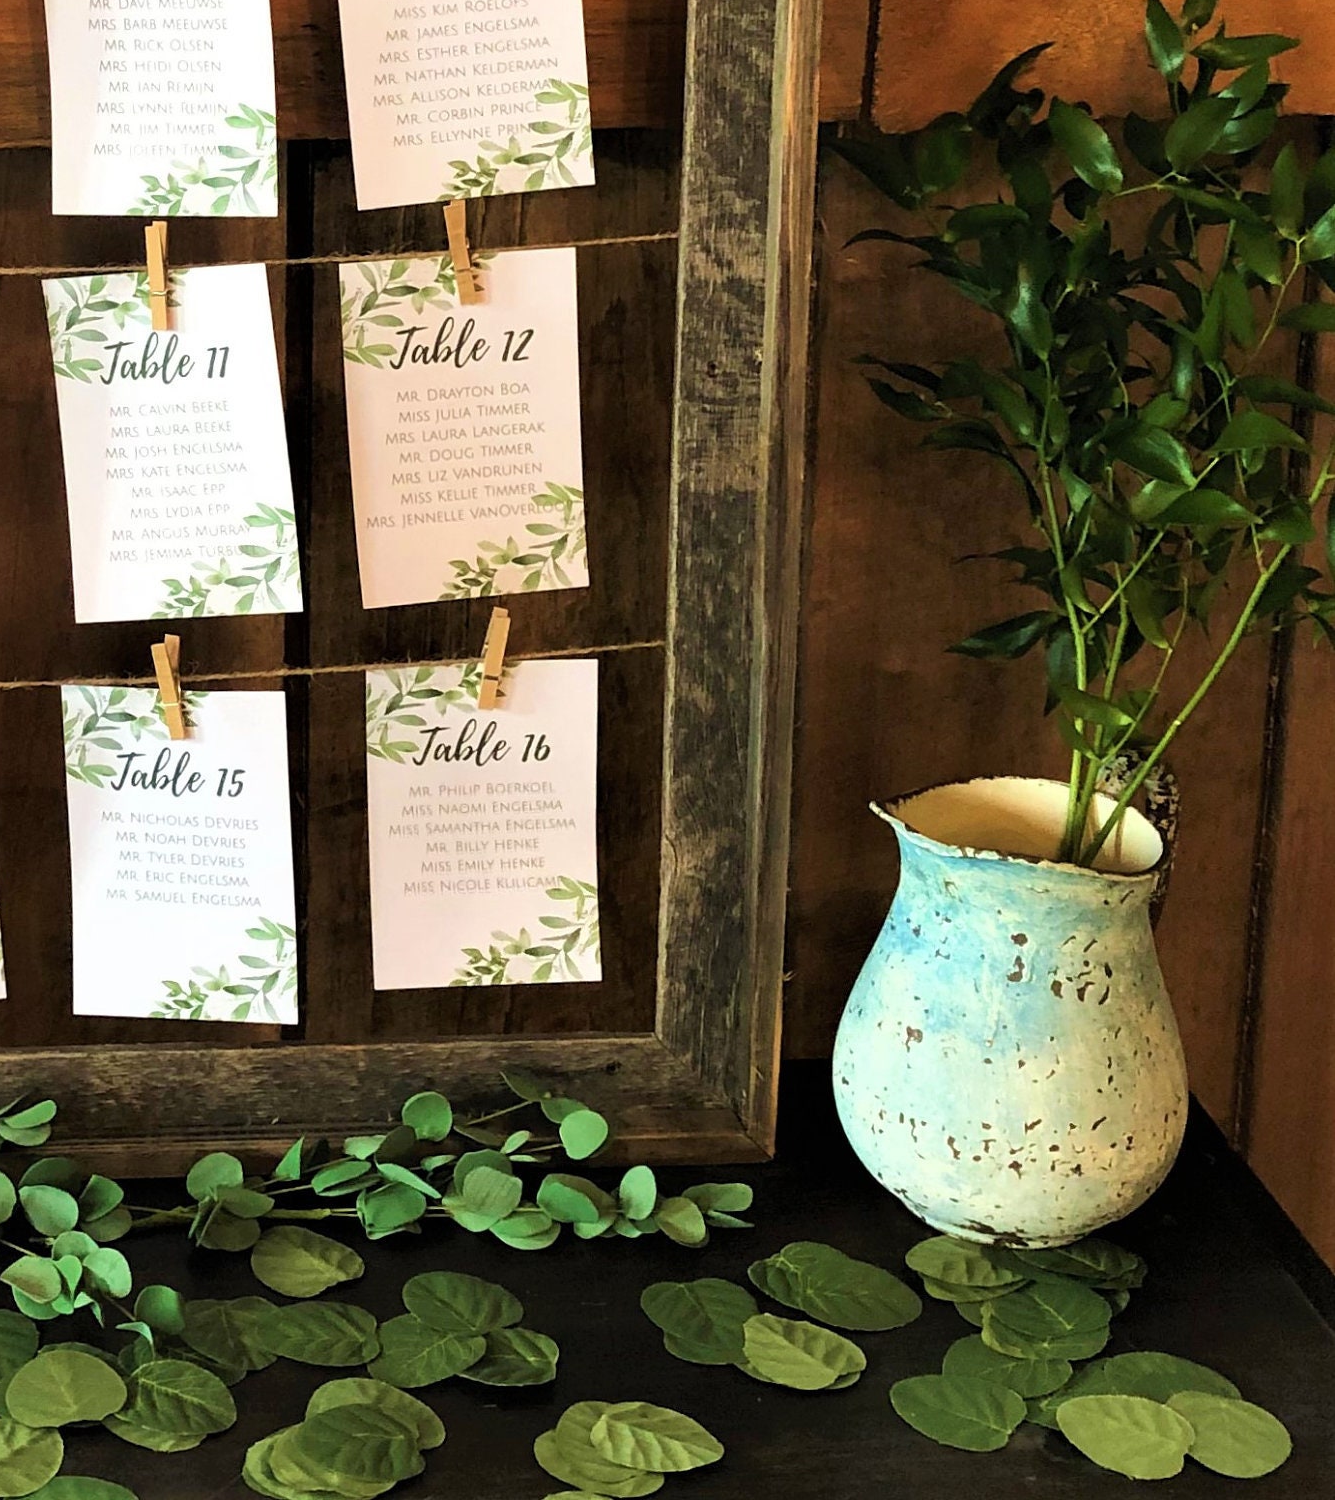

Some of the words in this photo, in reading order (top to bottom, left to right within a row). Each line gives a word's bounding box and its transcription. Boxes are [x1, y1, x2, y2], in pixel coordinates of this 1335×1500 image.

[416, 44, 470, 61] ESTHER
[474, 36, 551, 55] ENGELSMA
[390, 317, 490, 369] Table
[502, 328, 534, 362] 12
[100, 332, 195, 385] Table
[207, 346, 229, 379] 11
[500, 381, 531, 396] BOA
[398, 409, 431, 424] MISS
[435, 406, 472, 425] JULIA
[475, 402, 531, 417] TIMMER
[421, 427, 468, 443] LAURA
[472, 421, 546, 439] LANGERAK
[412, 718, 510, 767] Table
[522, 734, 550, 763] 16
[111, 748, 205, 797] Table
[216, 768, 245, 798] 15
[130, 811, 200, 828] NICHOLAS
[401, 804, 434, 819] MISS
[438, 802, 487, 816] NAOMI
[491, 799, 563, 815] ENGELSMA
[144, 832, 187, 845] NOAH
[455, 840, 490, 853] BILLY
[493, 837, 540, 853] HENKE
